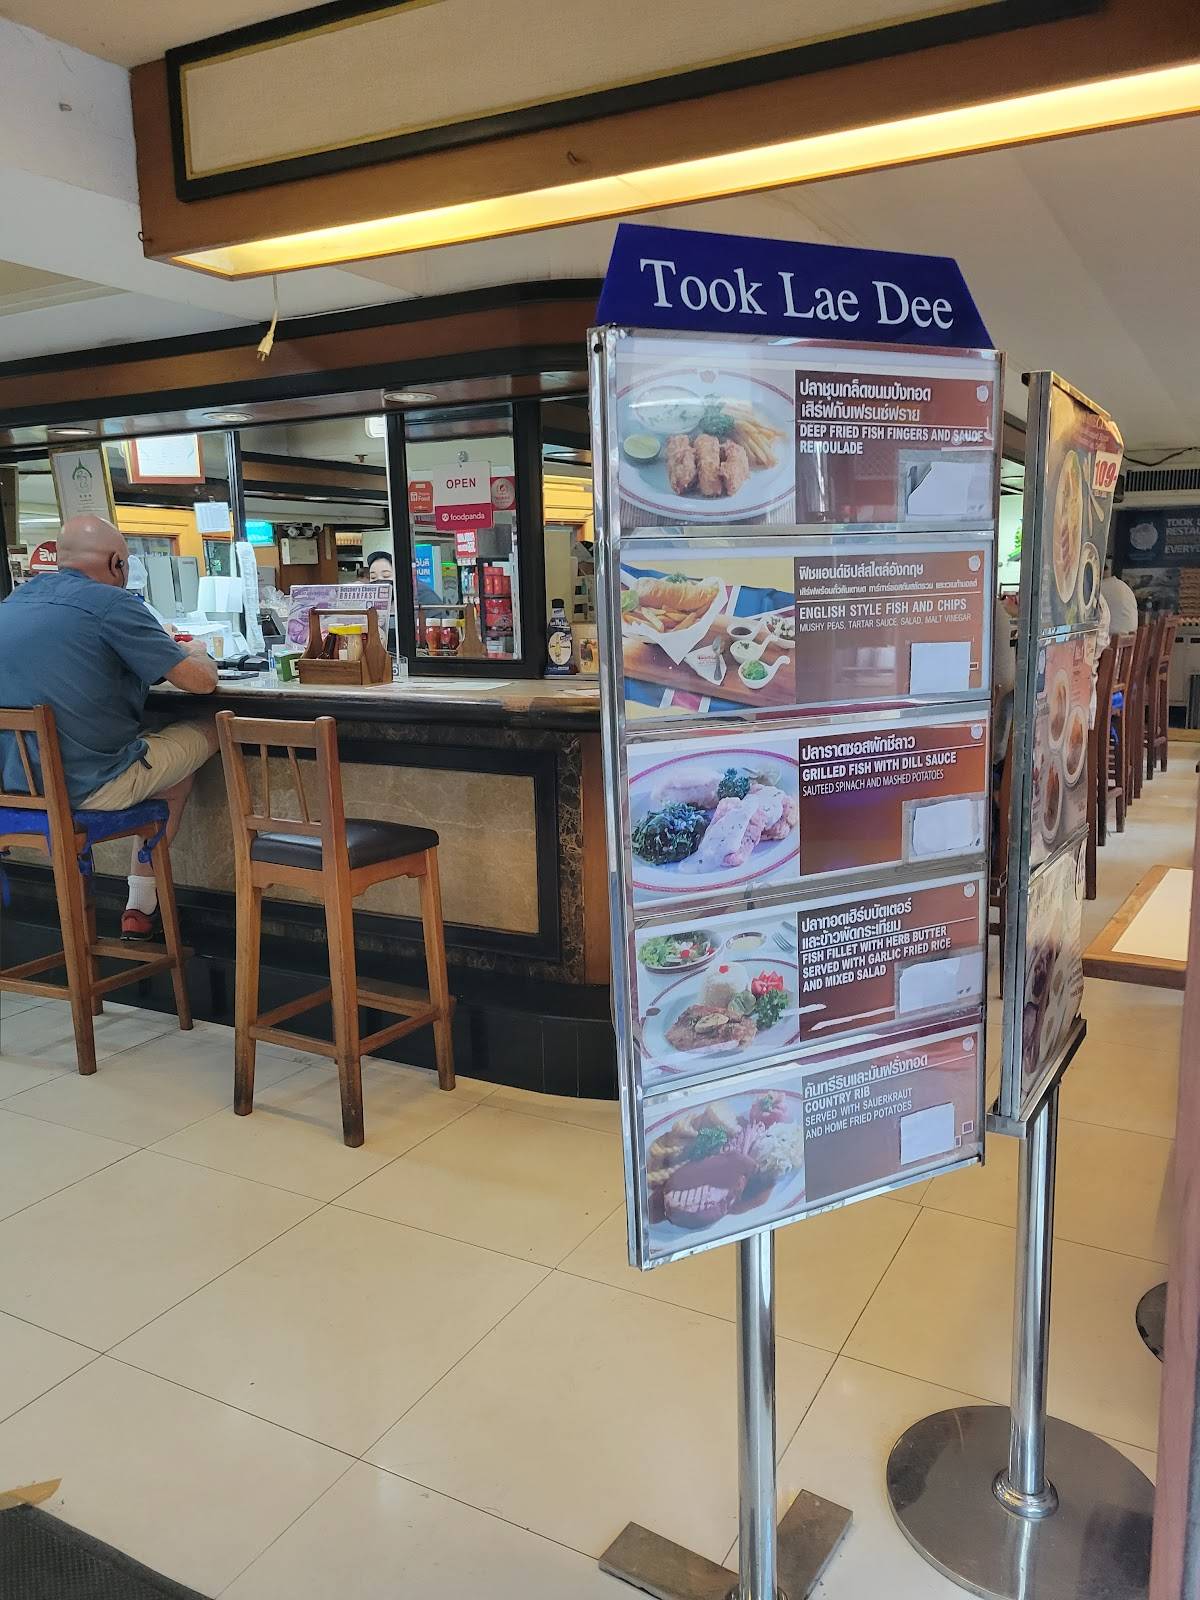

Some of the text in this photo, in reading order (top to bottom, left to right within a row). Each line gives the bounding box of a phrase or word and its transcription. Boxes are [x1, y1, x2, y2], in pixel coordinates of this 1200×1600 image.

[640, 258, 954, 330] Took Lae Dee
[800, 424, 826, 438] DEEP
[829, 425, 859, 439] FRIED
[862, 427, 884, 440] FISH
[887, 428, 928, 441] FINGERS
[931, 429, 950, 442] AND
[446, 477, 476, 489] OPEN
[450, 512, 485, 522] foodpanda
[340, 592, 377, 600] BREAKFAST
[800, 598, 967, 620] ENGLISH STYLE FISH AND CHIPS
[800, 621, 824, 632] MUSHY
[849, 618, 874, 629] TARTAR
[925, 614, 942, 624] MALT
[944, 612, 971, 622] VINEGAR
[802, 751, 957, 782] GRILLED FISH WITH DILL SAUCE
[802, 769, 944, 797] SAUTEED SPINACH AND MASHED POTATOES
[802, 925, 947, 966] FISH FILLET WITH HERB BUTTER
[802, 938, 951, 979] SERVED WITH GARLIC FRIED RICE
[802, 964, 886, 993] AND MIXED SALAD
[805, 1086, 870, 1114] COUNTRY RIB
[805, 1087, 913, 1127] SERVED WITH SAUERKRAUT
[805, 1100, 912, 1141] AND HOME FRIED POTATOES
